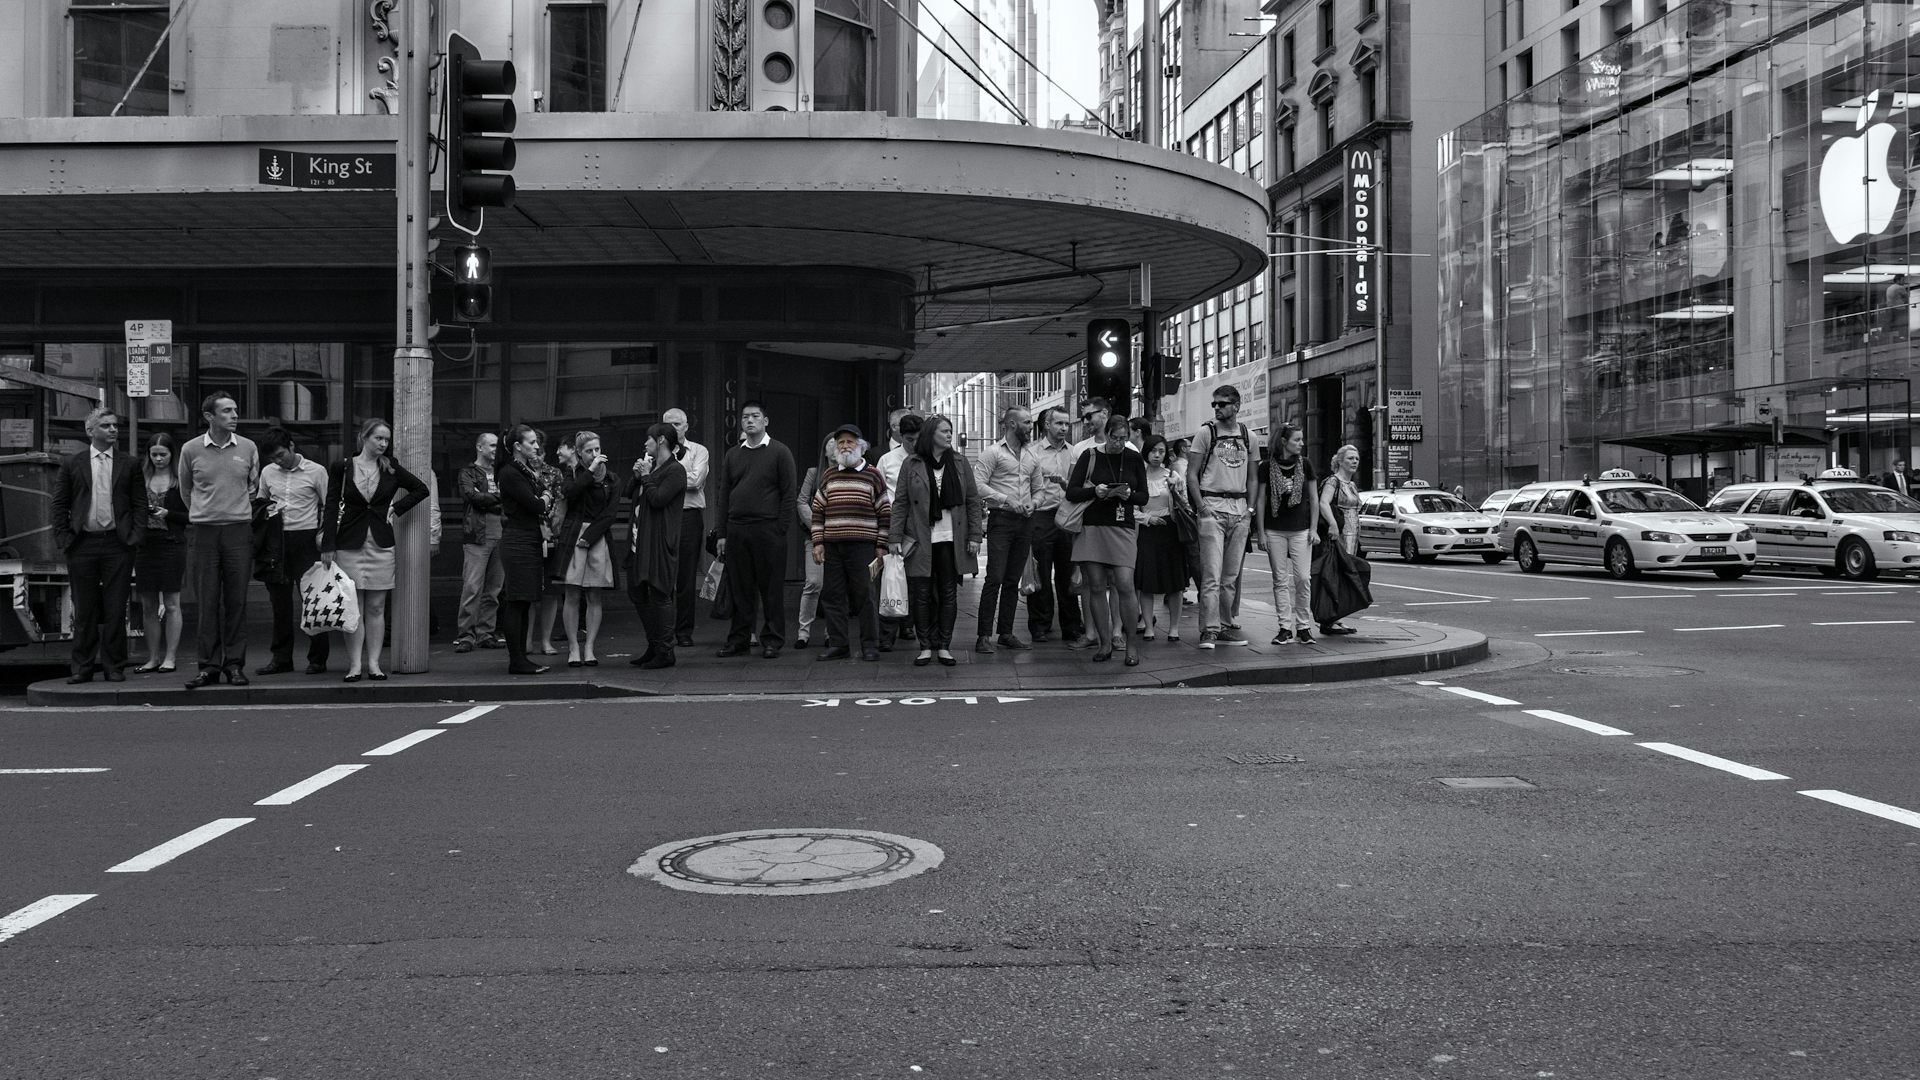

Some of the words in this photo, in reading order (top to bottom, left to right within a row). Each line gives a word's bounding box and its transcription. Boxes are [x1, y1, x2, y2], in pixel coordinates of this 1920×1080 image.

[309, 157, 350, 178] King
[354, 158, 372, 174] St
[1353, 174, 1369, 312] McDonald's
[130, 324, 144, 332] 4P
[156, 346, 166, 354] NO
[801, 697, 978, 707] LOOK
